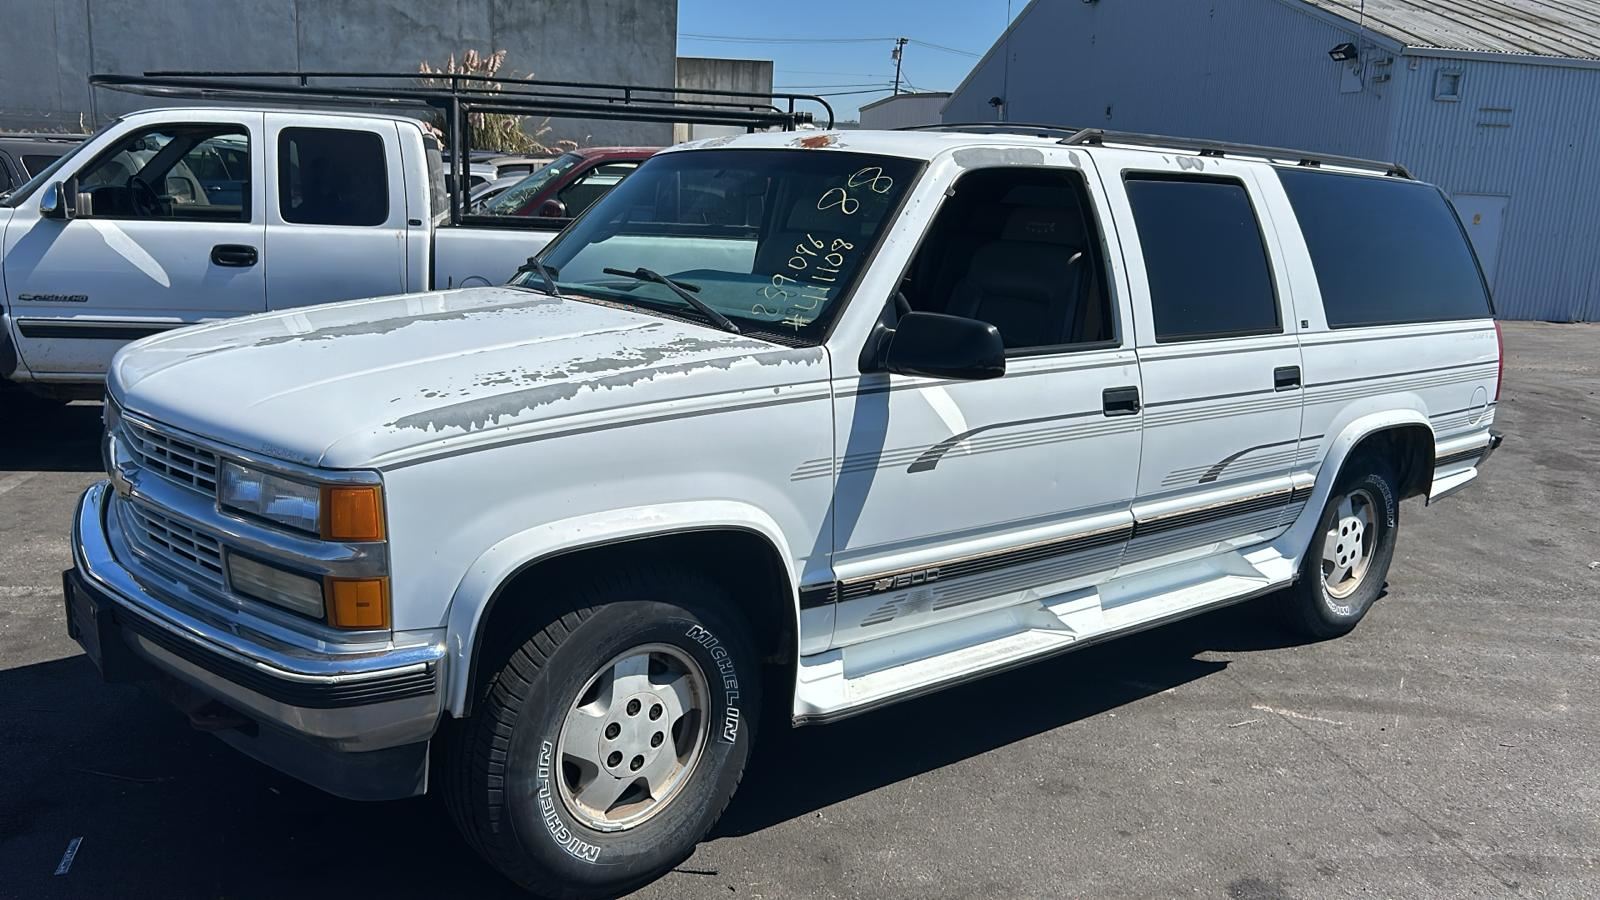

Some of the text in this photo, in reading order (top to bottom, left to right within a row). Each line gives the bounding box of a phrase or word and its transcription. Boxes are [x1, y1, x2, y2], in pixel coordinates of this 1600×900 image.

[817, 167, 893, 214] 88
[893, 569, 939, 588] 1500
[685, 625, 740, 744] MICHELIN
[538, 741, 600, 863] MICHELIN
